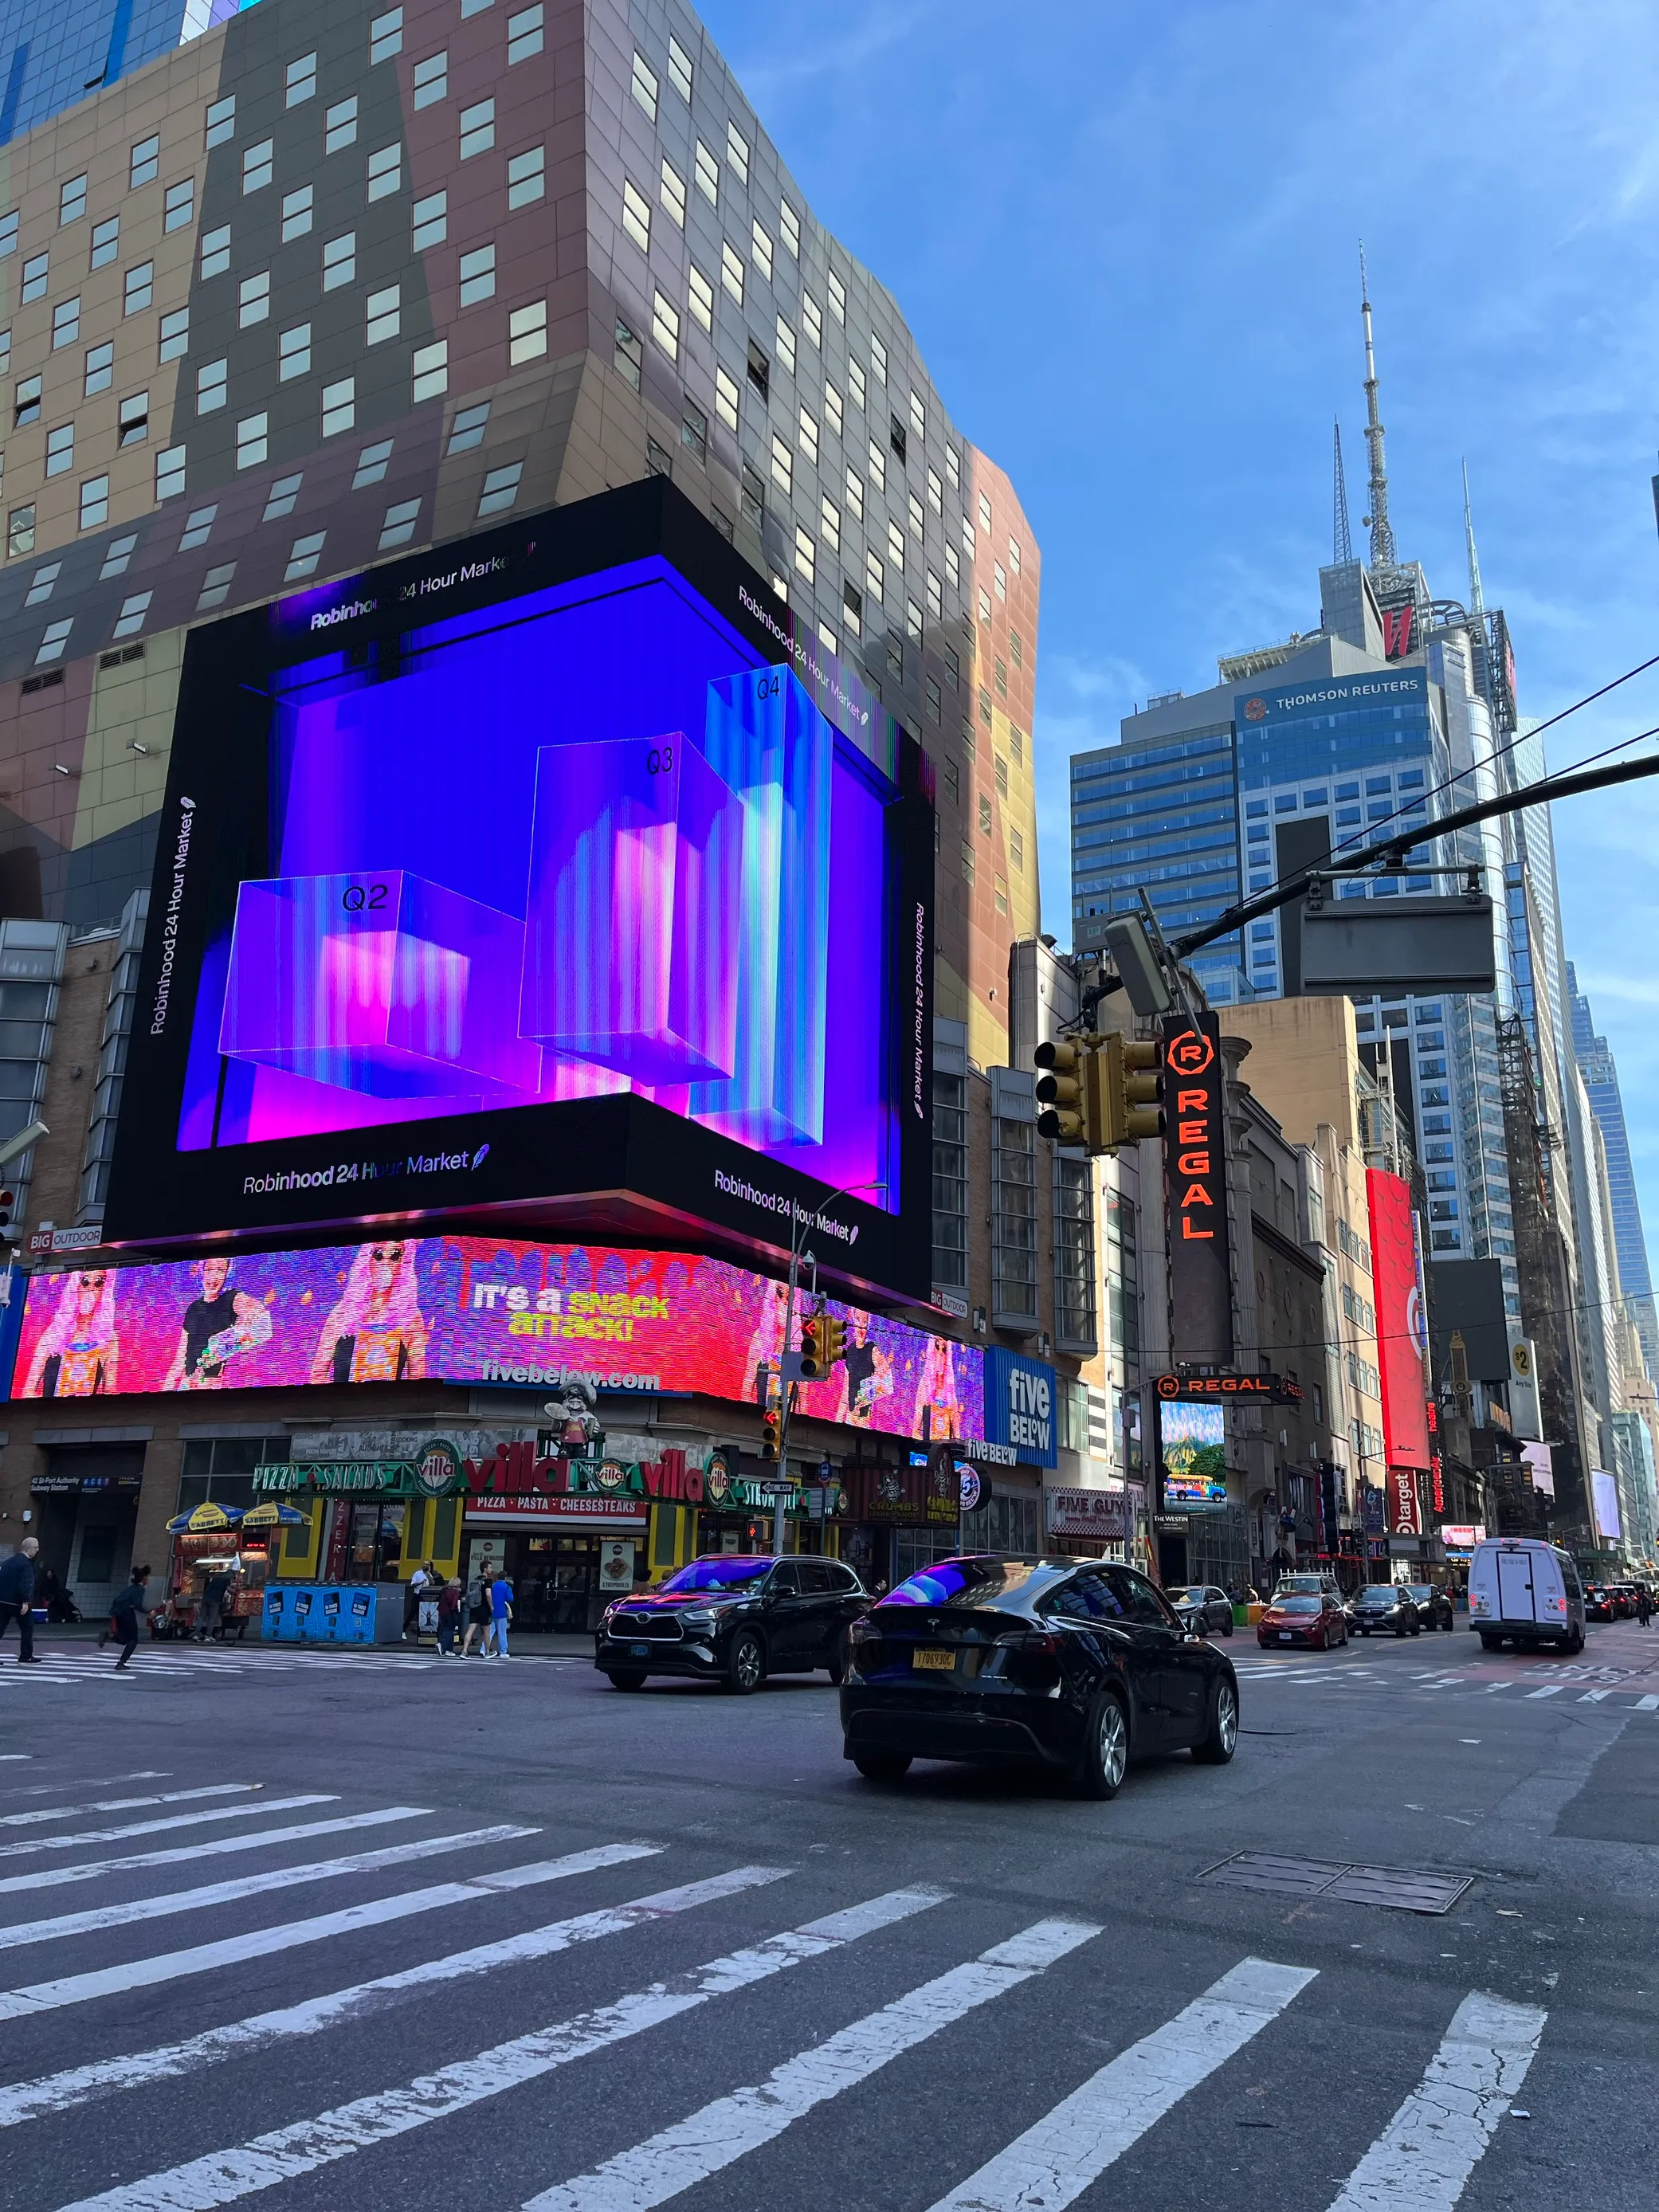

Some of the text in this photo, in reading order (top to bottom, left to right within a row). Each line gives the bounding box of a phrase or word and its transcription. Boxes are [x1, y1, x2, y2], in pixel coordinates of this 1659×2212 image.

[420, 571, 458, 595] Hour
[738, 585, 861, 720] Robinhood 24 Hour Market
[758, 676, 780, 700] Q4
[1276, 680, 1418, 710] THOMSON REUTERS
[646, 747, 673, 776] Q3
[342, 884, 388, 911] Q2
[150, 811, 194, 1035] Robinhood 24 Hour Market
[916, 901, 924, 987] Robinhood
[916, 988, 924, 1006] 24
[914, 1049, 923, 1101] Market
[244, 1151, 469, 1194] Robinhood 24 Hour Market
[1177, 1089, 1214, 1240] REGAL
[715, 1169, 776, 1212] Robinhood
[777, 1196, 791, 1217] 24
[817, 1213, 849, 1241] Market
[30, 1230, 100, 1249] BIG OUTDOOR
[536, 1287, 561, 1313] a
[931, 1291, 942, 1306] BIG
[1515, 1351, 1528, 1370] $2
[482, 1358, 661, 1391] fivebelow.com
[1188, 1379, 1271, 1392] REGAL
[1008, 1368, 1050, 1418] five
[1426, 1402, 1437, 1433] heatre
[968, 1438, 988, 1461] five
[252, 1465, 387, 1491] PIZZA SALADS
[417, 1457, 454, 1477] villa
[461, 1441, 571, 1493] villa
[595, 1468, 625, 1481] villa
[639, 1448, 704, 1502] villa
[707, 1469, 729, 1490] villa
[477, 1496, 636, 1514] PIZZA PASTA CHEESESTEAKS
[869, 1501, 920, 1512] CRUMBS
[1057, 1496, 1088, 1512] FIVE
[1394, 1473, 1414, 1521] target
[191, 1517, 225, 1529] SABRETT
